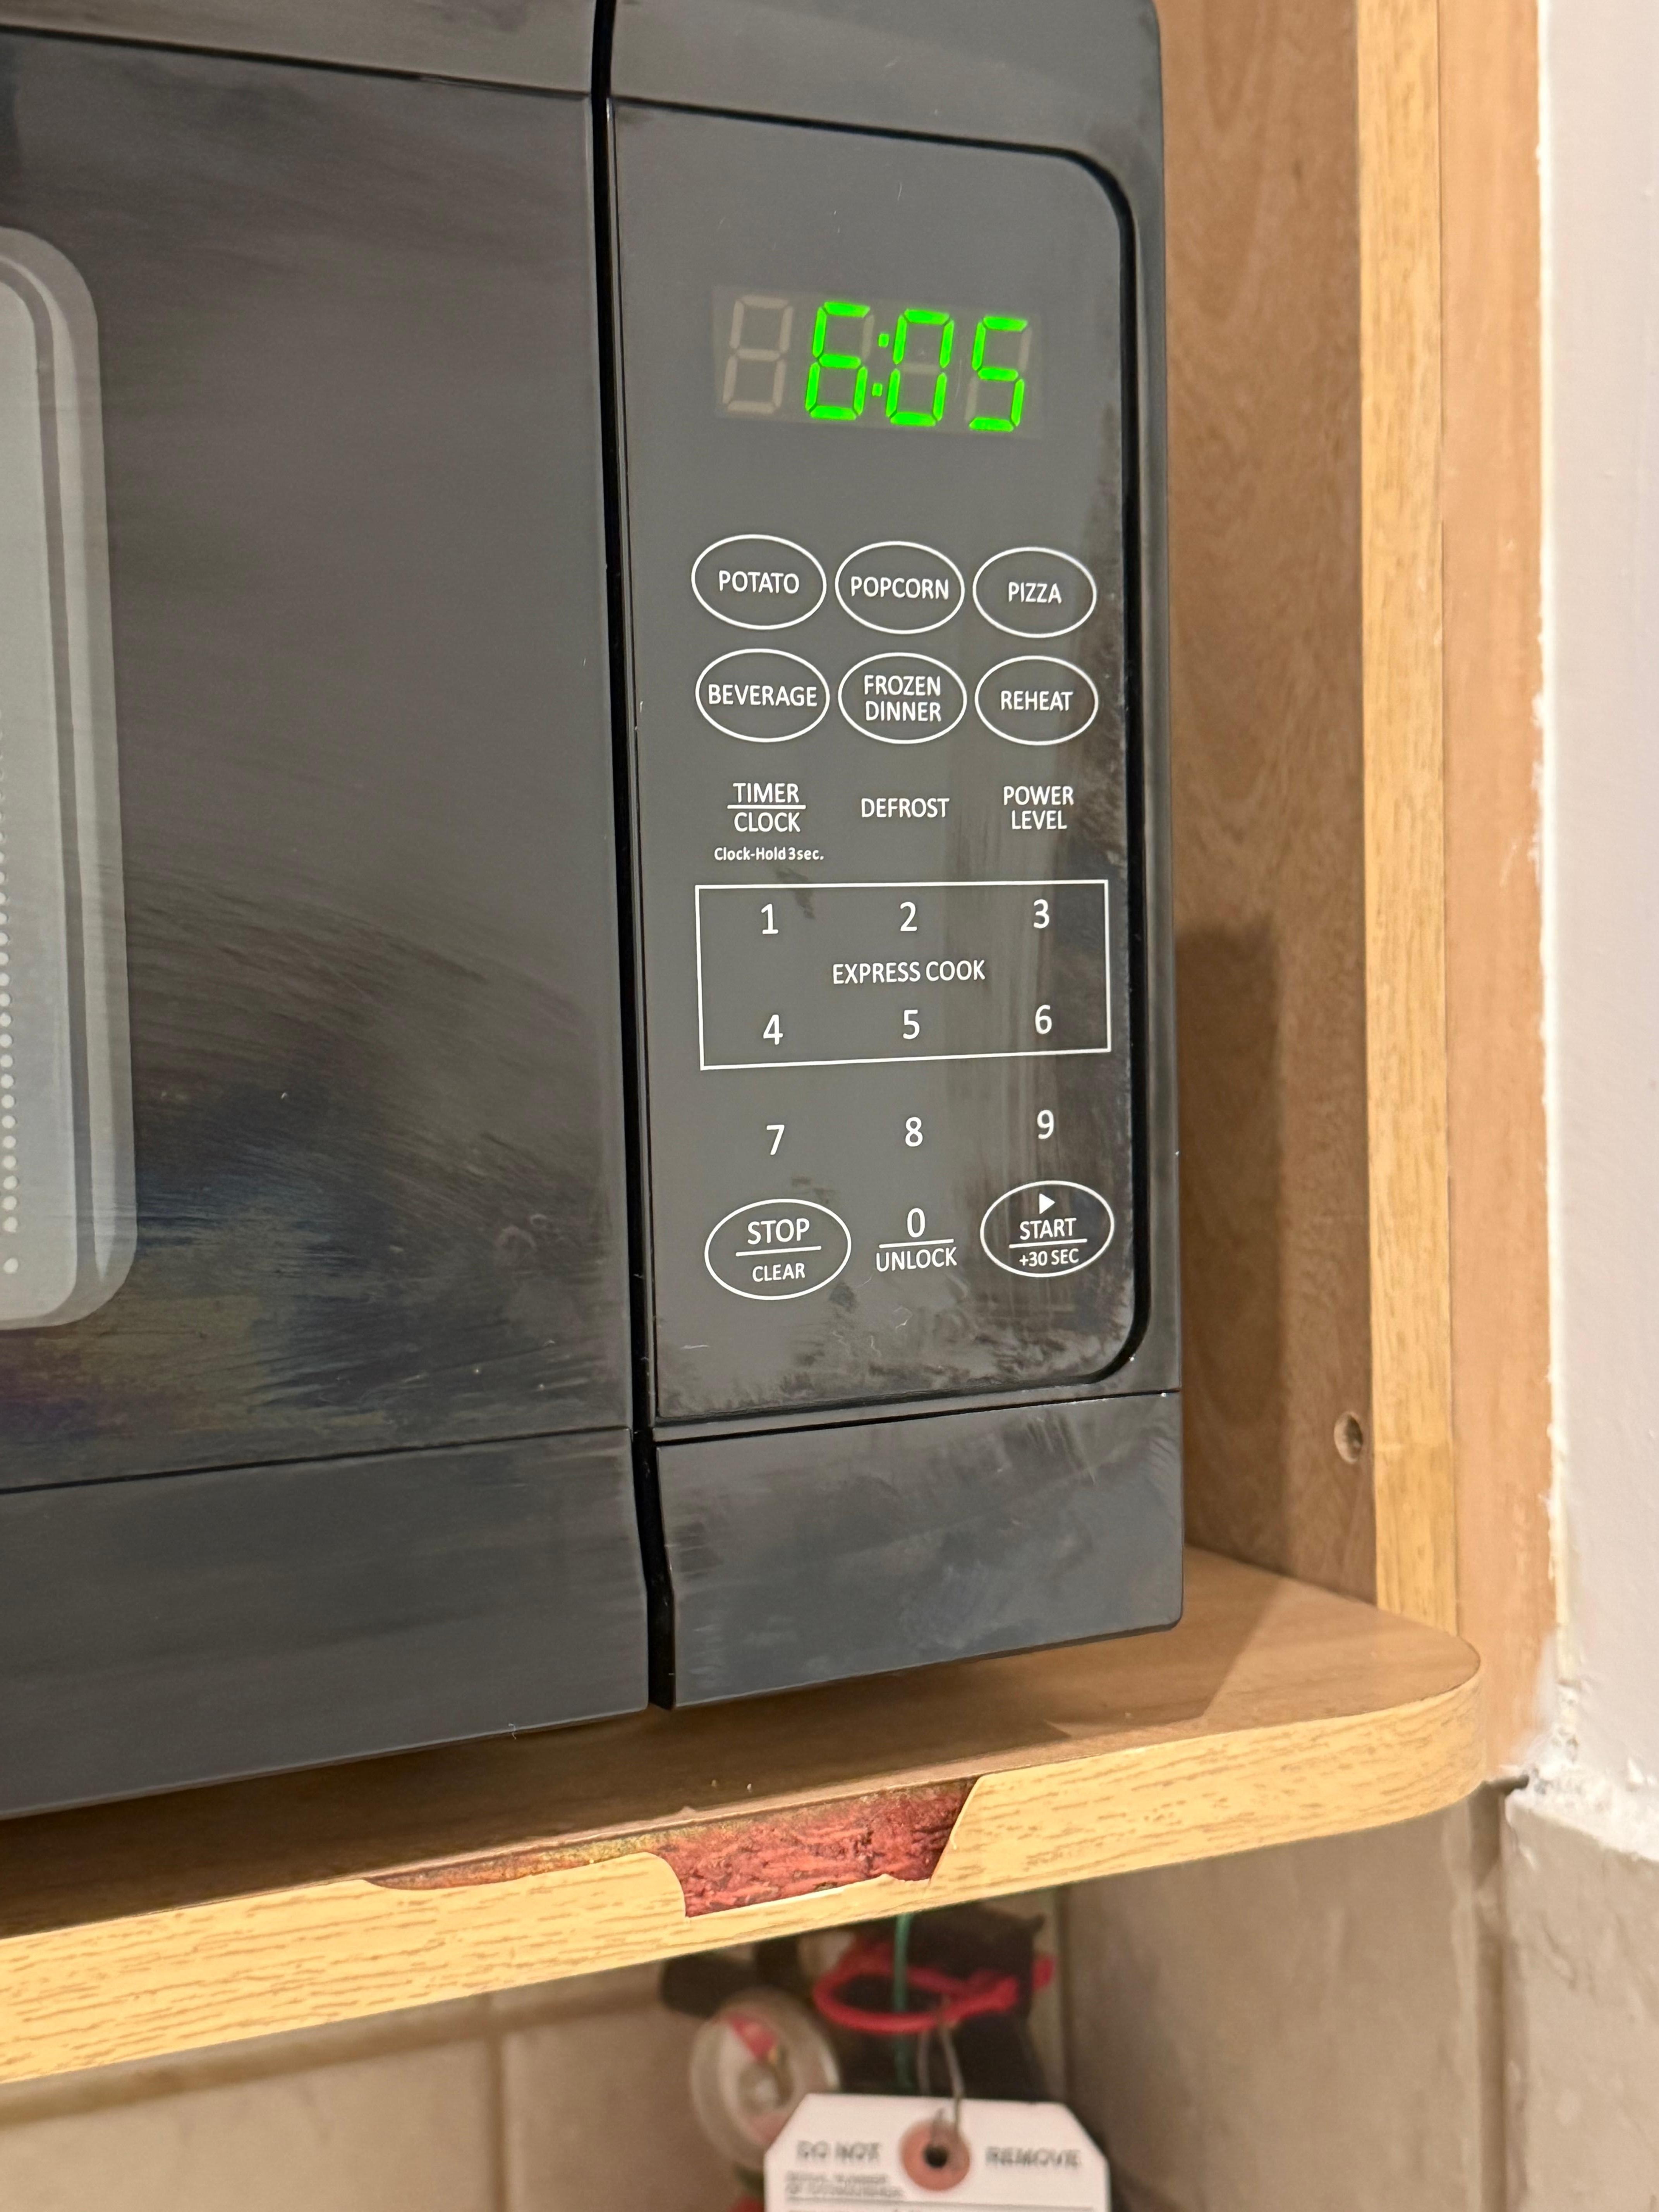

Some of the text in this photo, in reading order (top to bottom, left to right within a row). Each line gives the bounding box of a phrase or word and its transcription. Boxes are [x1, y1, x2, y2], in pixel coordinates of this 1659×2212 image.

[805, 301, 1027, 431] 6:05
[719, 570, 799, 594] POTATO
[851, 576, 949, 600] POPCORN
[1008, 582, 1062, 604] PIZZA
[708, 683, 818, 707] BEVERAGE
[864, 675, 941, 696] FROZEN
[866, 701, 942, 722] DINNER
[1001, 690, 1073, 711] REHEAT
[733, 782, 800, 804] TIMER
[1003, 785, 1074, 805] POWER
[861, 797, 950, 818] DEFROST
[734, 812, 801, 833] CLOCK
[1011, 810, 1067, 830] LEVEL
[714, 846, 787, 861] Clock-Hold
[761, 903, 779, 935] 1
[900, 901, 918, 932] 2
[1033, 898, 1050, 929] 3
[833, 959, 986, 984] EXPRESS COOK
[763, 1014, 783, 1045] 4
[903, 1009, 920, 1040] 5
[1035, 1004, 1053, 1035] 6
[905, 1116, 923, 1147] 8
[1037, 1109, 1054, 1140] 9
[766, 1124, 785, 1156] 7
[747, 1218, 811, 1245] STOP
[907, 1207, 926, 1238] 0
[1019, 1218, 1077, 1240] START
[876, 1247, 957, 1272] UNLOCK
[1019, 1247, 1080, 1267] +30 SEC
[752, 1262, 805, 1283] CLEAR
[986, 2146, 1082, 2168] REMOVE
